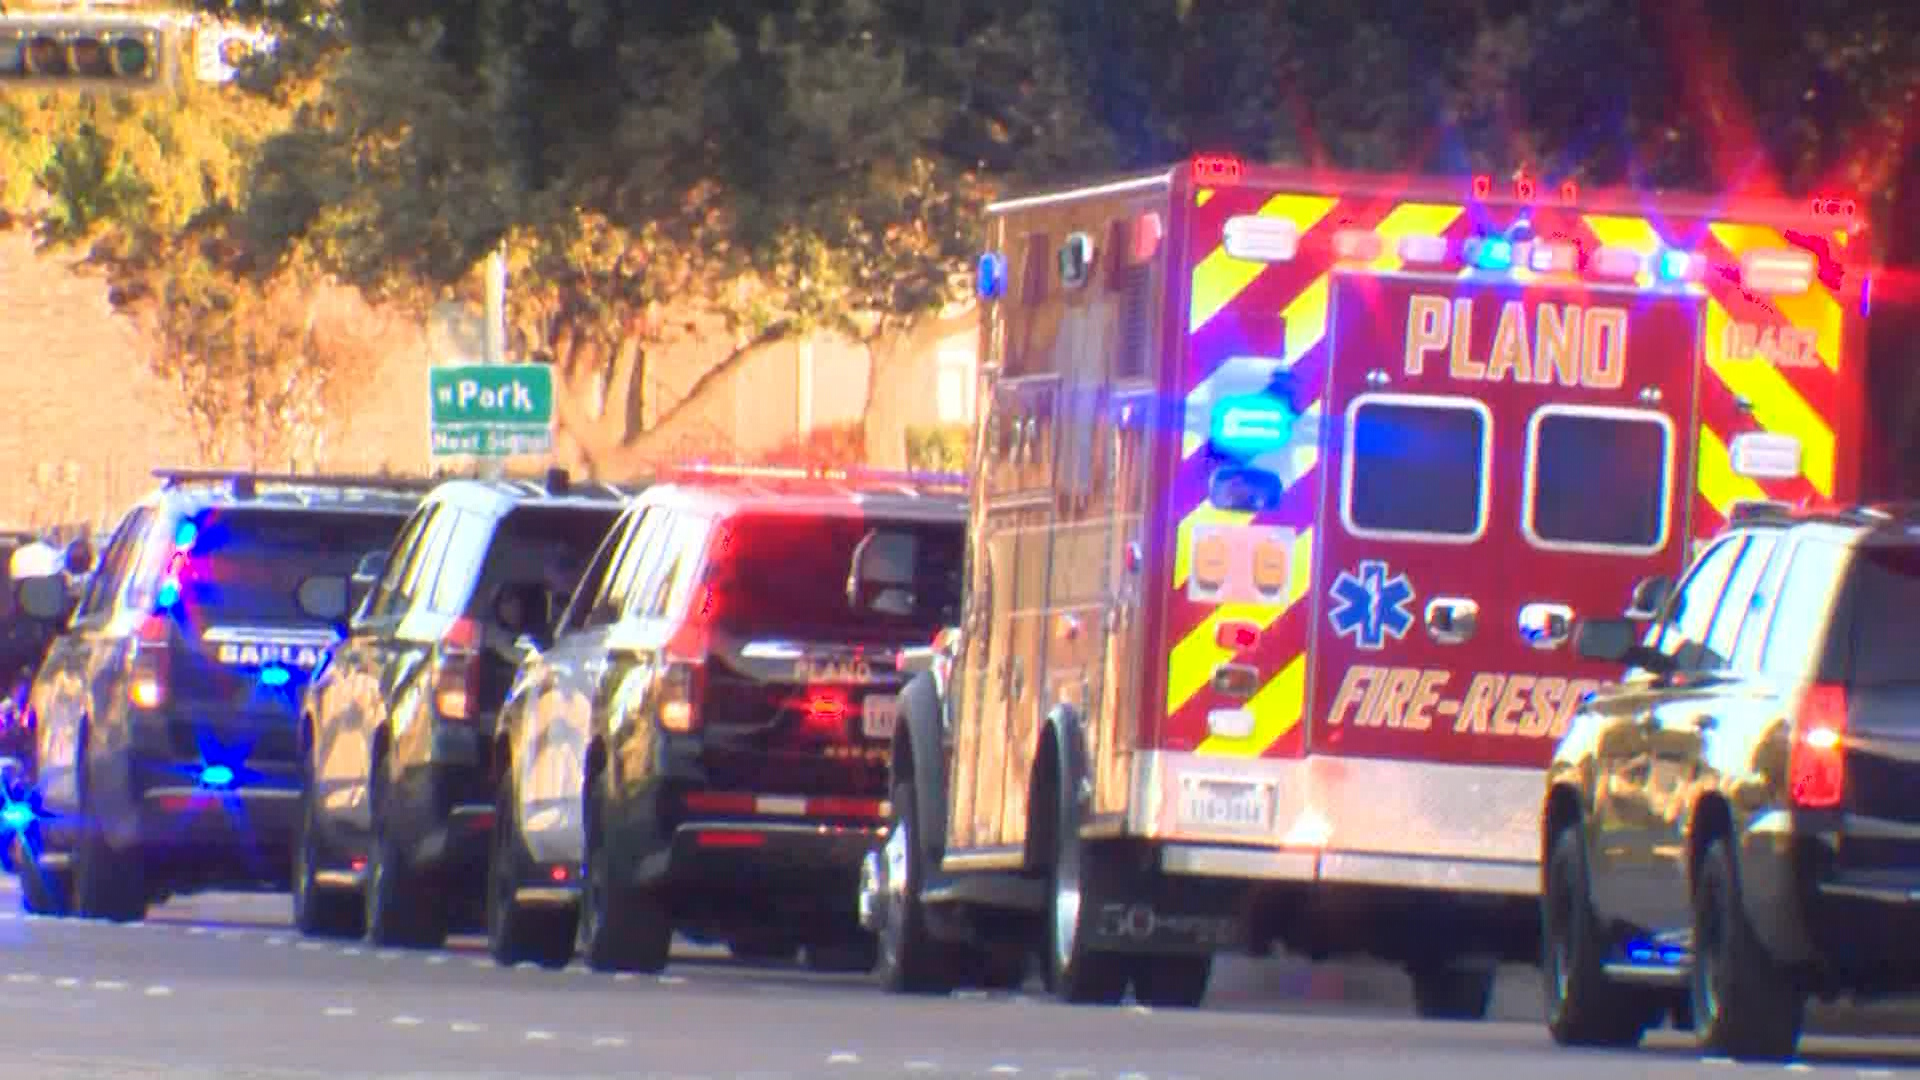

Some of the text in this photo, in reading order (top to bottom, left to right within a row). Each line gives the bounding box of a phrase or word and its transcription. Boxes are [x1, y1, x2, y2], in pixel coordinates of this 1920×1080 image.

[1404, 294, 1629, 389] PLANO
[457, 379, 534, 412] Park
[793, 659, 873, 683] PLANO
